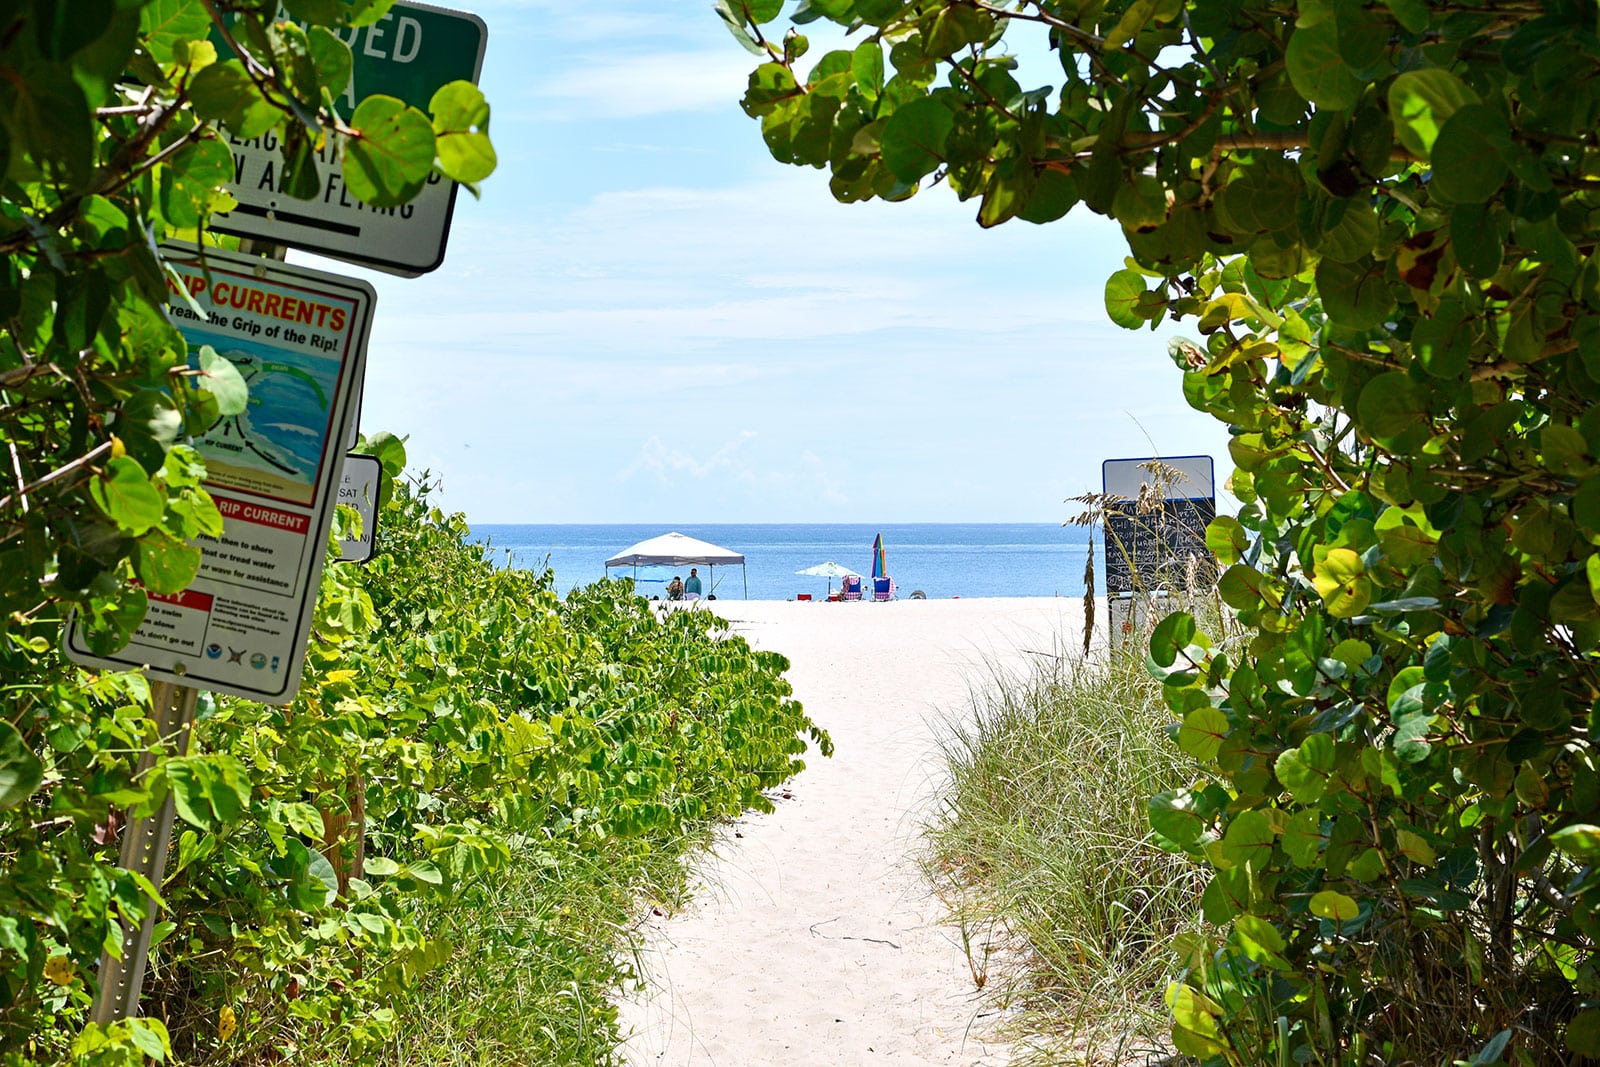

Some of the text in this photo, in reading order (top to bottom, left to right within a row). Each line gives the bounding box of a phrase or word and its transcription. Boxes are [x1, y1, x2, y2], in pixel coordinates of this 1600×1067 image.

[212, 281, 347, 332] CURRENTS
[205, 311, 229, 328] the
[232, 316, 261, 337] Grip
[265, 325, 280, 339] of
[283, 328, 307, 345] the
[310, 333, 339, 352] Rip!
[338, 487, 358, 498] SAT
[219, 500, 304, 530] RIP CURRENT
[220, 537, 239, 547] then
[241, 541, 249, 549] to
[251, 544, 274, 555] shore
[229, 553, 251, 565] tread
[252, 558, 276, 571] water
[211, 566, 231, 575] wave
[233, 570, 245, 579] for
[246, 573, 289, 589] assistance
[161, 609, 182, 618] swim
[153, 619, 176, 629] alone
[169, 636, 179, 644] go
[181, 639, 194, 647] out
